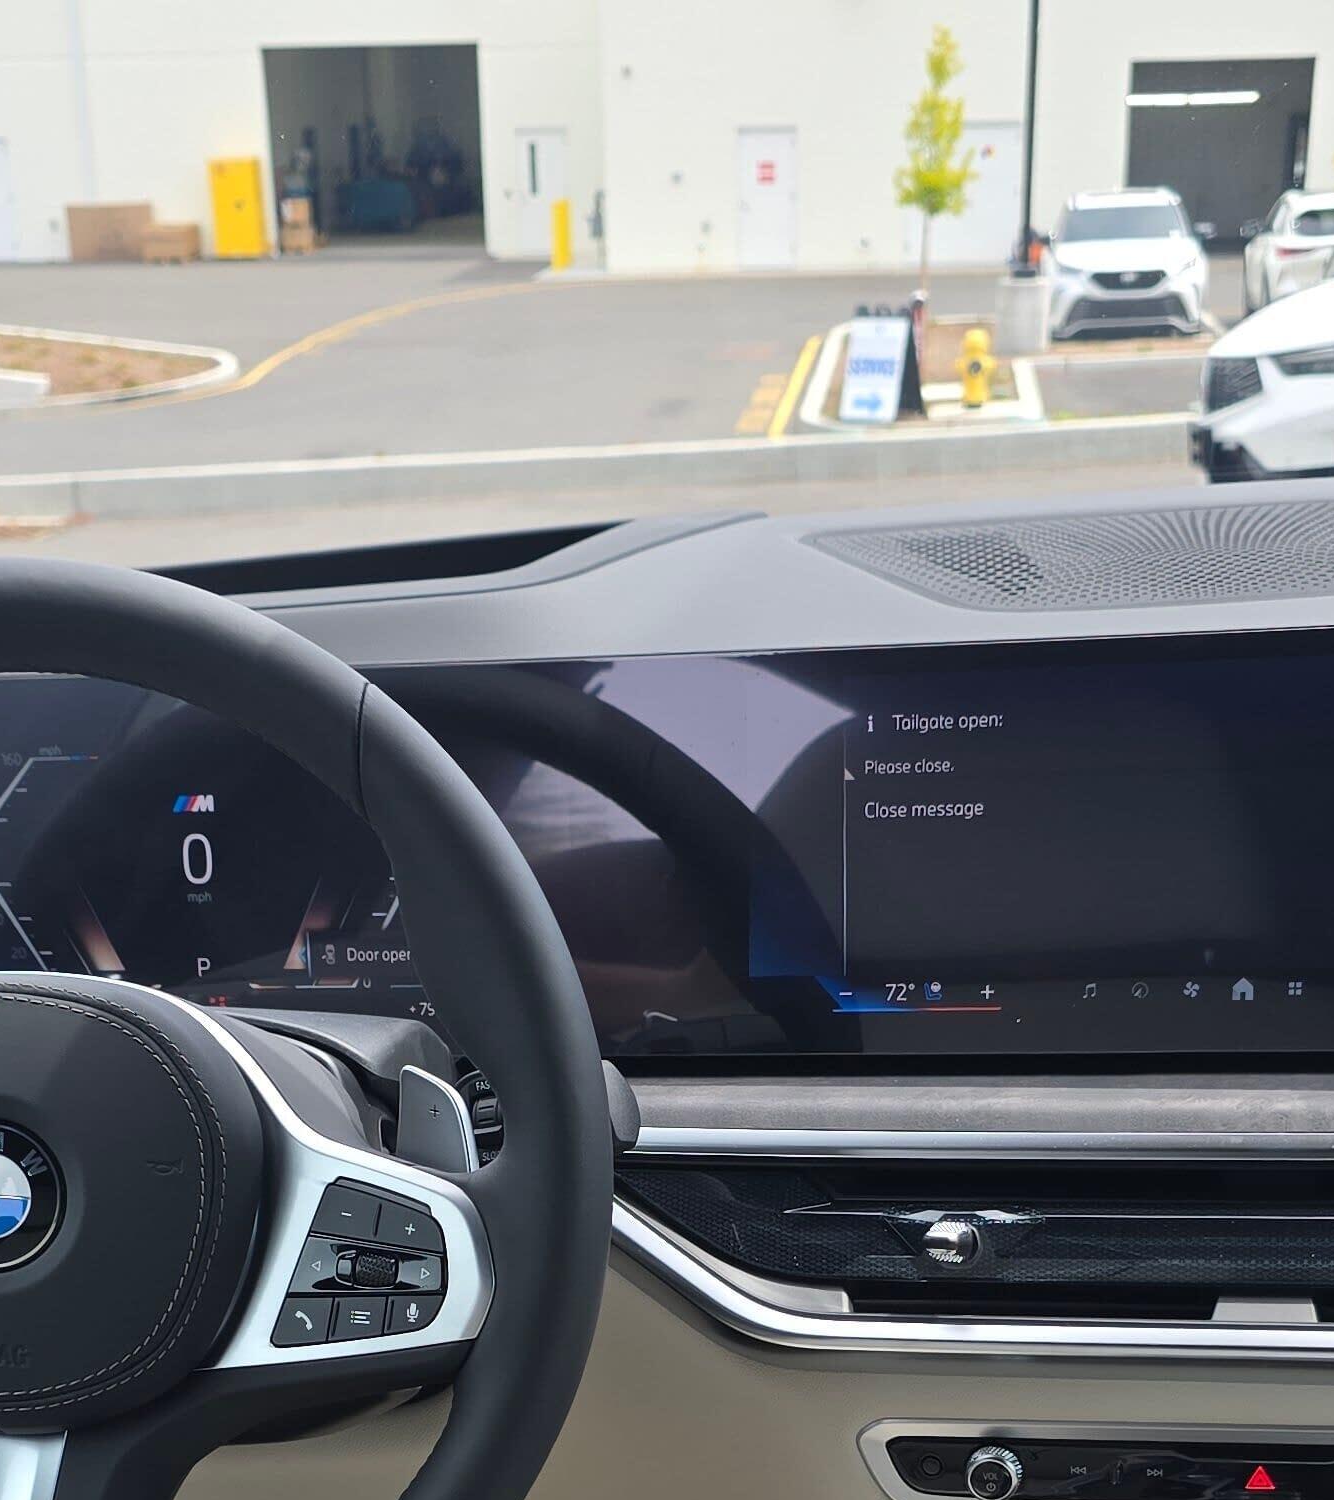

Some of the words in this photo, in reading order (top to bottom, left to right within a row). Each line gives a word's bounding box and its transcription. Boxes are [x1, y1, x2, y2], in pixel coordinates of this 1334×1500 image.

[892, 714, 953, 734] Tailgate
[958, 714, 1003, 732] open:
[865, 760, 911, 774] Please
[915, 758, 955, 773] close.
[865, 802, 907, 819] Close
[912, 803, 984, 819] message
[182, 833, 213, 884] 0
[187, 891, 212, 904] mph
[11, 946, 27, 959] 20
[347, 947, 379, 962] Door
[197, 957, 211, 977] P
[475, 1081, 491, 1091] FAS
[983, 1472, 998, 1481] VOL
